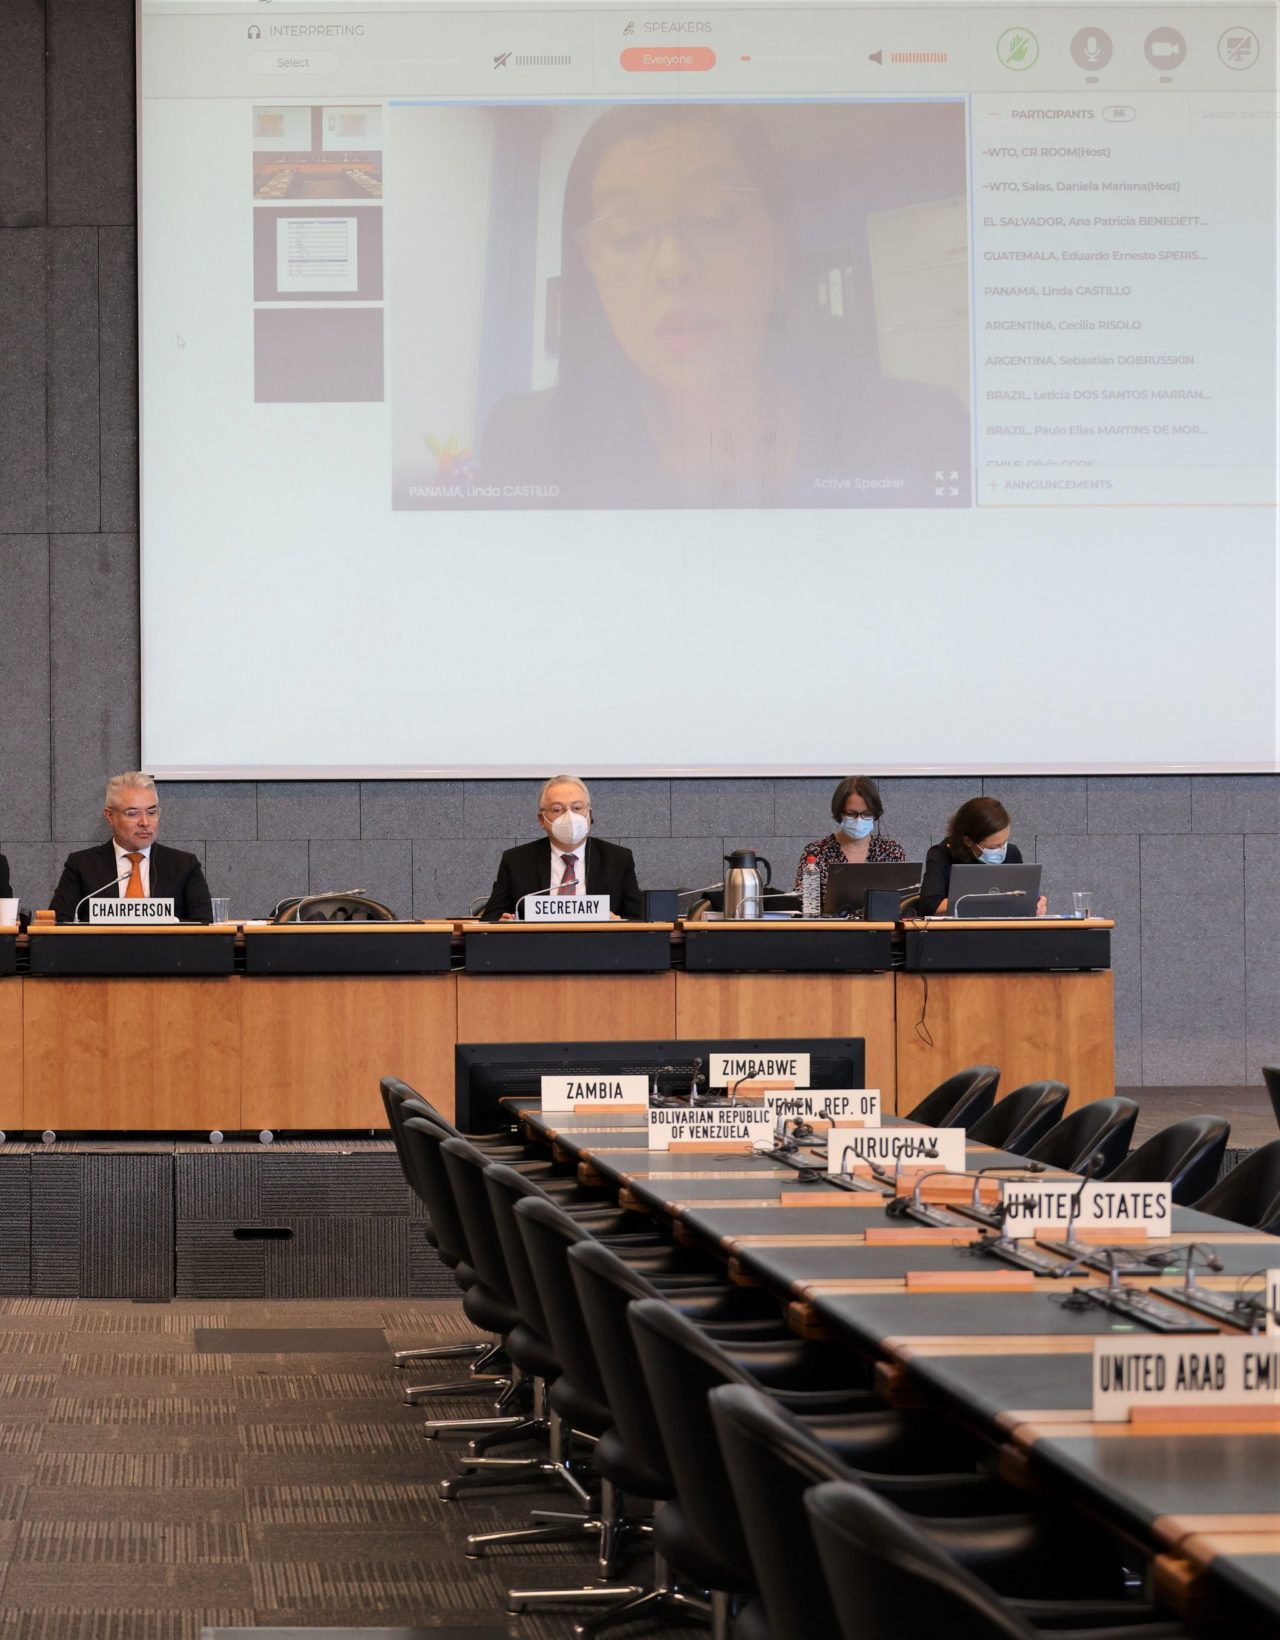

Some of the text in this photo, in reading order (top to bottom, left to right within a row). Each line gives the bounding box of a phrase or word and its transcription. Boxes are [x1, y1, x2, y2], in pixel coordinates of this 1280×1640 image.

[269, 24, 364, 36] INTERPRETING
[644, 21, 712, 32] SPEAKERS
[277, 57, 309, 68] Select
[644, 53, 693, 66] Everyone
[1012, 109, 1094, 120] PARTICIPANTS
[1022, 147, 1037, 157] CR
[1057, 180, 1098, 192] Daniela
[984, 216, 997, 226] EL
[1068, 216, 1090, 226] Ana
[1094, 215, 1136, 226] Patricia
[1062, 250, 1109, 261] Eduardo
[1112, 250, 1156, 261] Ernesto
[1042, 285, 1073, 296] Linda
[1076, 285, 1131, 296] CASTILLO
[1059, 319, 1095, 330] Cecilia
[1098, 319, 1141, 330] RISOLO
[1117, 355, 1194, 366] DOBRUSSKIN
[1074, 389, 1098, 400] DOS
[1101, 389, 1148, 400] SANTOS
[1034, 425, 1066, 436] Paulo
[1070, 424, 1095, 436] Elias
[1098, 424, 1150, 435] MARTINS
[1153, 424, 1169, 435] DE
[467, 484, 500, 497] Linda
[503, 485, 559, 497] CASTILLO
[813, 477, 904, 492] Active Speaker
[1004, 479, 1112, 490] ANNOUNCEMENTS
[92, 901, 172, 919] CHAIRPERSON
[535, 898, 600, 916] SECRETARY
[722, 1059, 797, 1076] ZIMBABWE
[566, 1081, 623, 1099] ZAMBIA
[824, 1096, 854, 1114] REP.
[860, 1096, 876, 1114] OF
[651, 1110, 770, 1125] BOLIVARIAN REPUBLIC
[672, 1125, 750, 1139] OF VENEZUELA
[854, 1137, 938, 1159] URUGUAY
[1007, 1193, 1167, 1219] UNITED STATES
[1099, 1352, 1166, 1392] UNITED
[1174, 1352, 1225, 1392] ARAB
